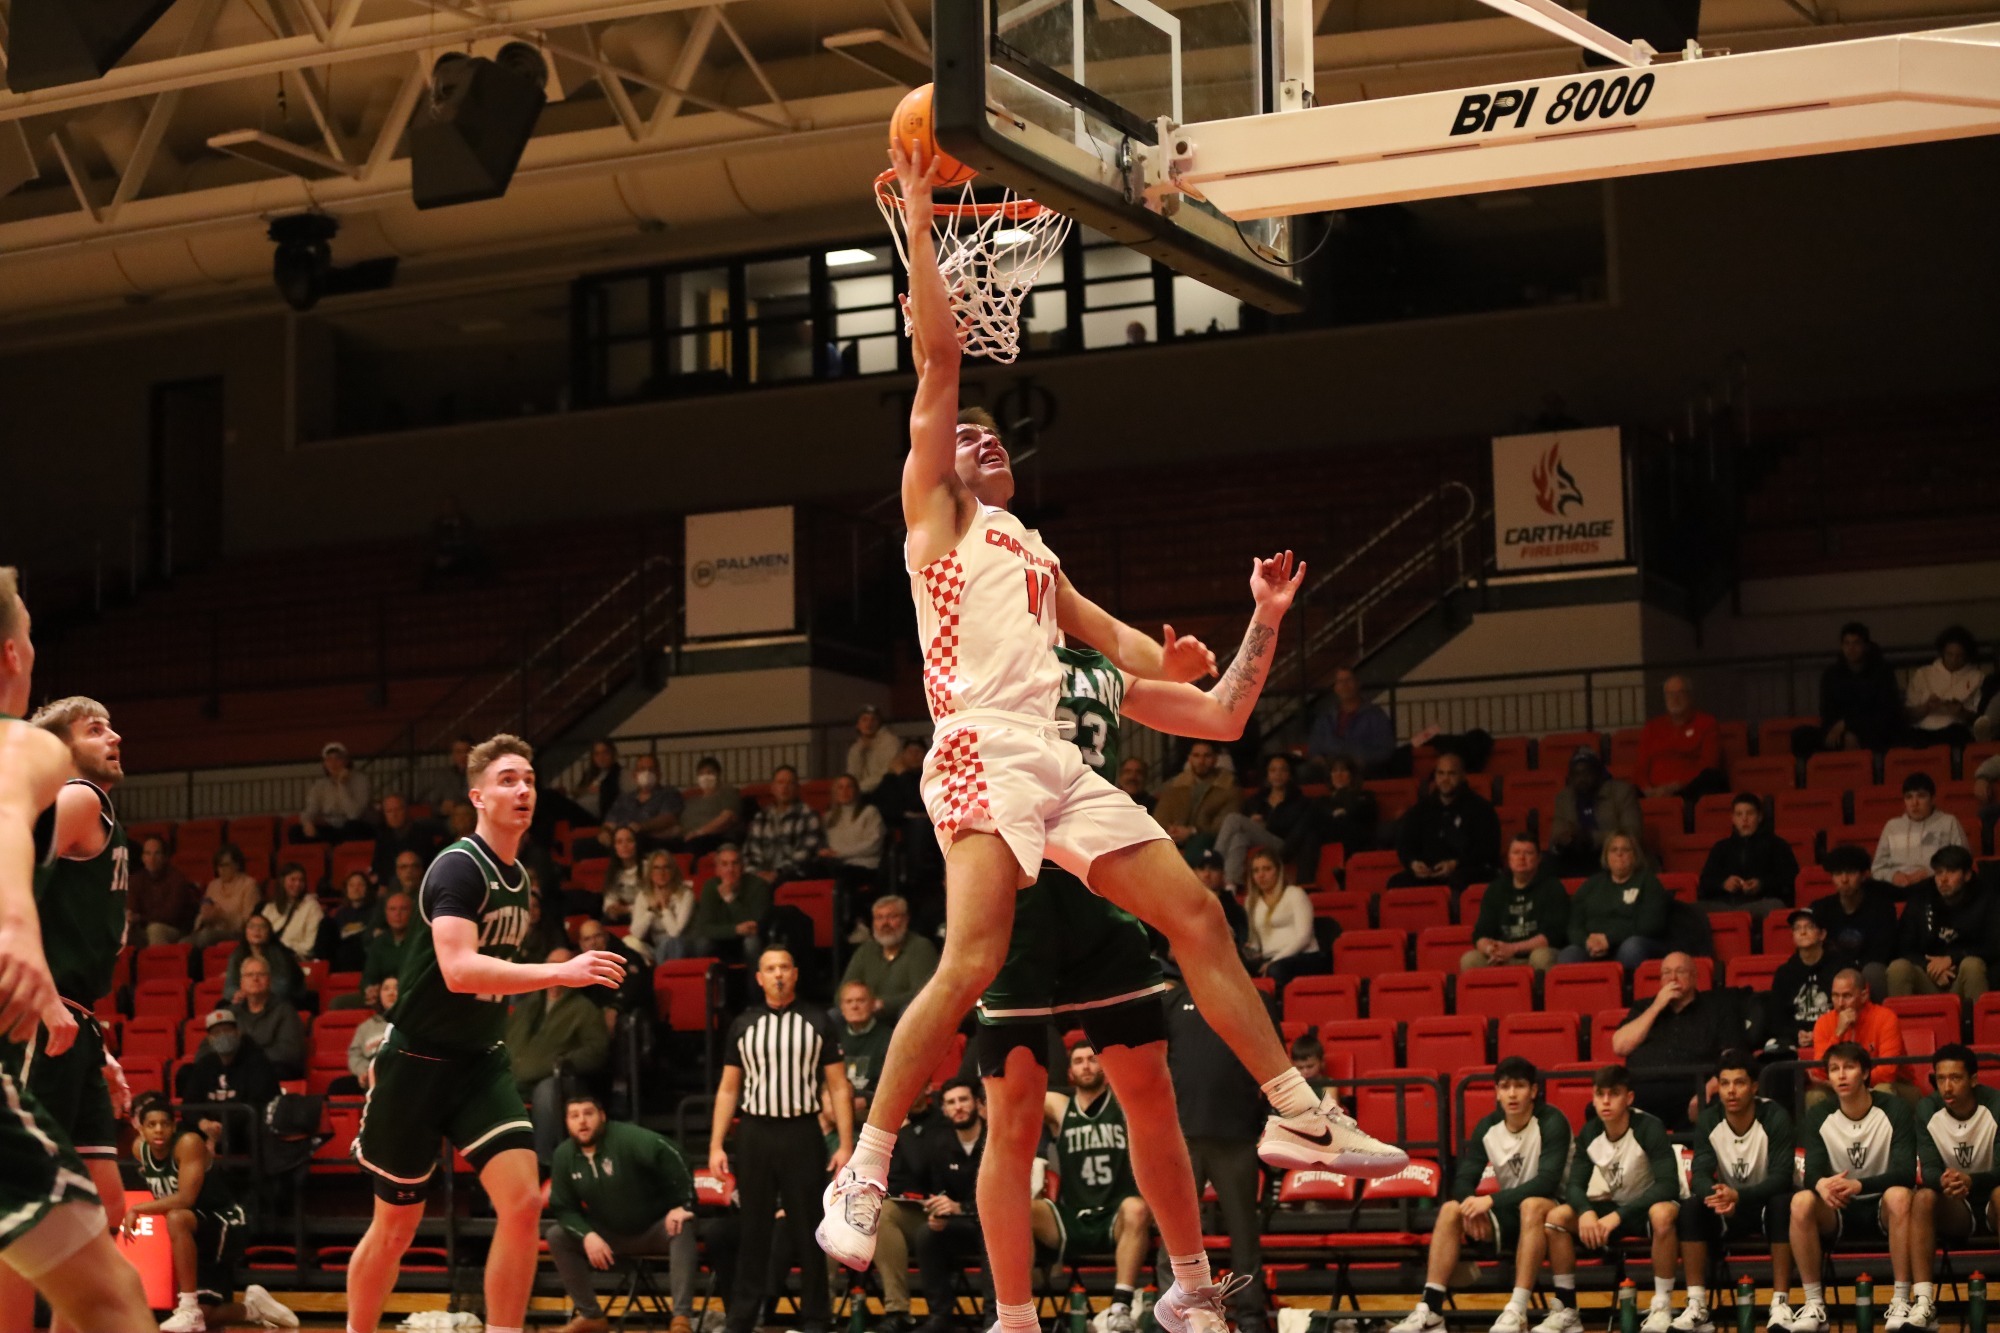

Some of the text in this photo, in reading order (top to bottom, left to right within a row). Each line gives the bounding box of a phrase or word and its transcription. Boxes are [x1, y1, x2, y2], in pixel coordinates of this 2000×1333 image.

[1449, 72, 1655, 136] BPI 8000
[1505, 519, 1614, 545] CARTHAGE
[716, 553, 789, 569] PALMEN
[985, 528, 1060, 588] CARTHA
[1065, 1123, 1126, 1153] TITANS
[1081, 1154, 1113, 1186] 45
